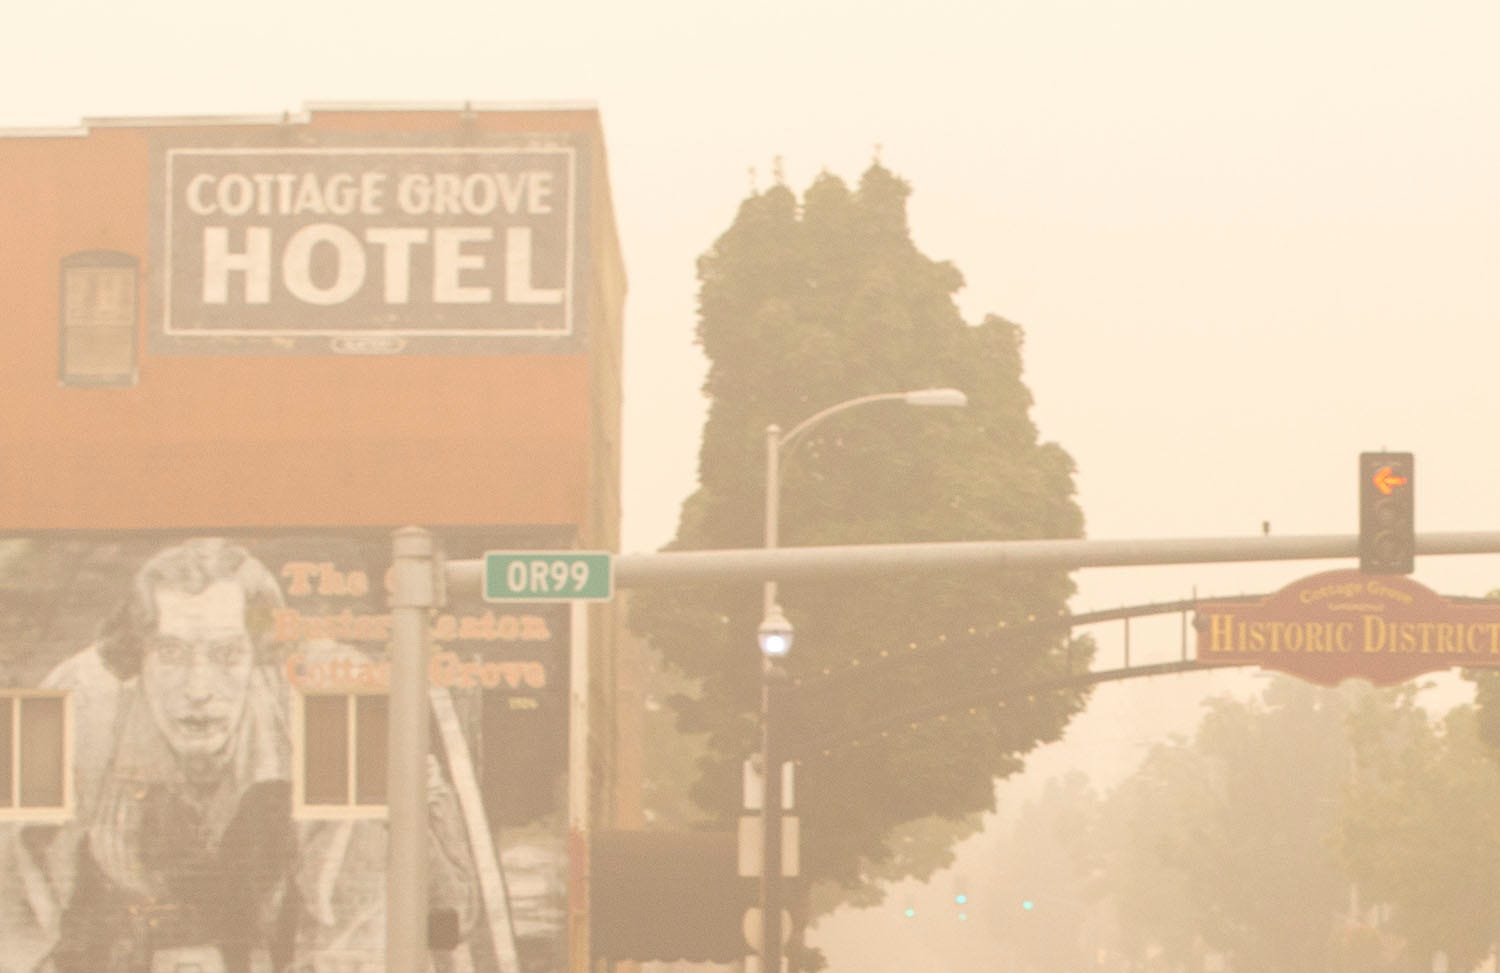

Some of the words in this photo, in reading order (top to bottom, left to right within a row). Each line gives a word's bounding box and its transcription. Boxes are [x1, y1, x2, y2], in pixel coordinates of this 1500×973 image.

[186, 172, 387, 215] COTTAGE
[398, 171, 553, 214] GROVE
[202, 222, 564, 306] HOTEL
[281, 561, 369, 597] The
[507, 560, 589, 592] OR99
[1299, 583, 1363, 604] Cottage
